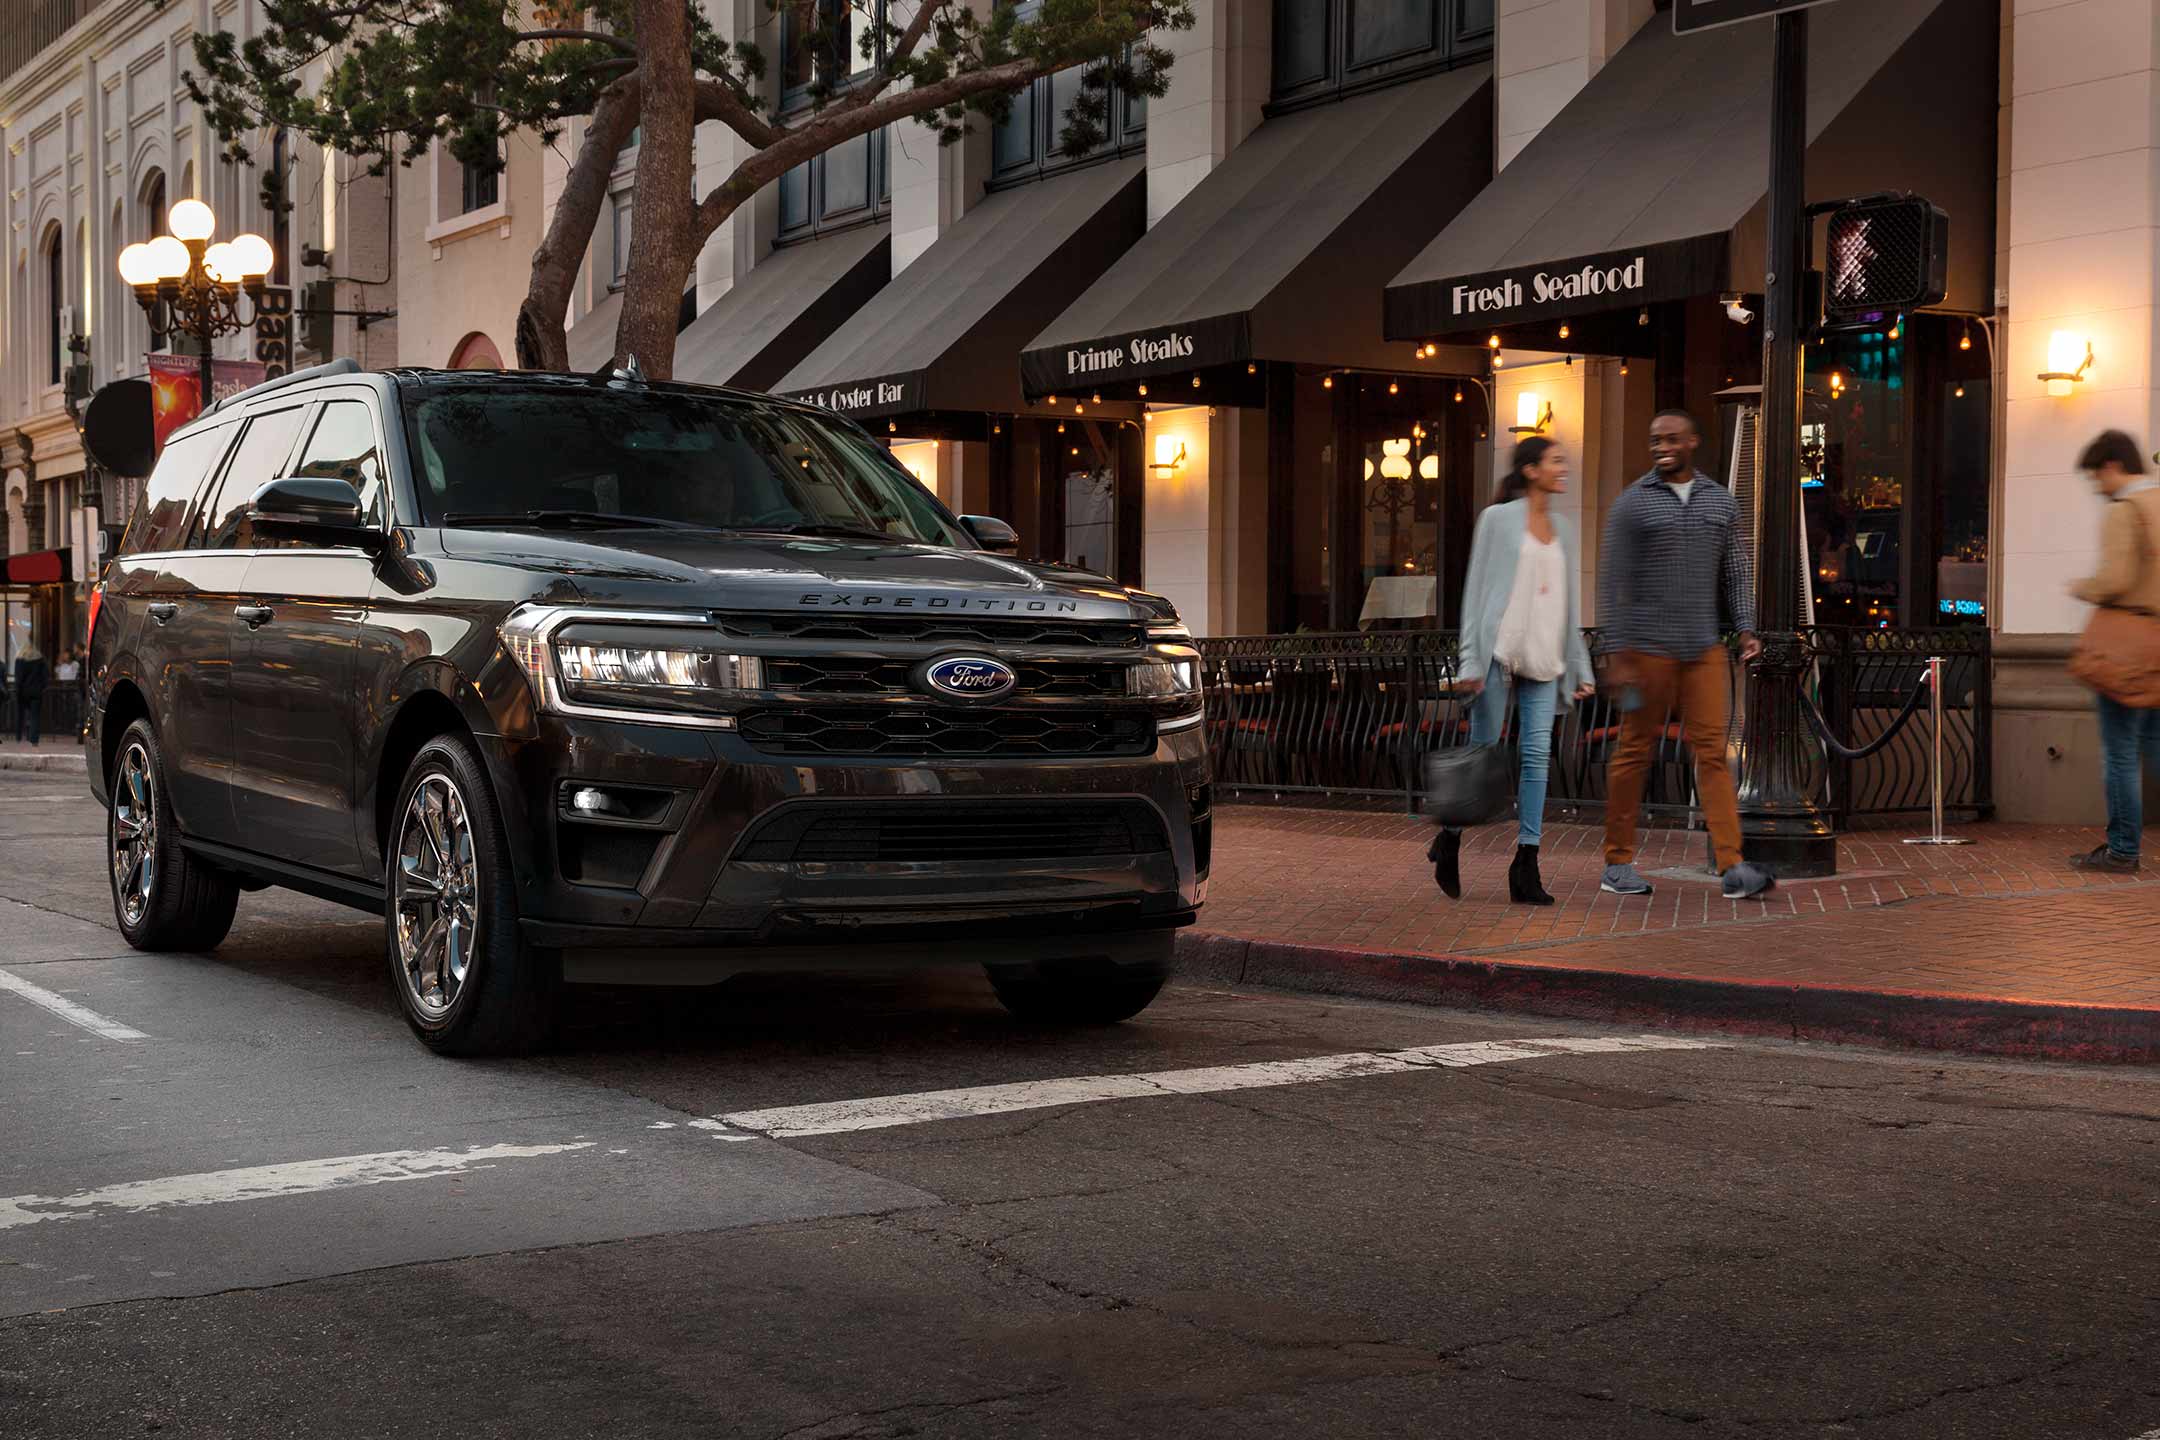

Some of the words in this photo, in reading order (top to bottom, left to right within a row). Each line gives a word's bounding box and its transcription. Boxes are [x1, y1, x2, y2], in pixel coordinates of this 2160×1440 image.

[1452, 278, 1523, 315] Fresh
[1532, 257, 1645, 304] Seafood
[1067, 347, 1124, 375] Prime
[1130, 333, 1194, 365] Steaks
[831, 387, 874, 411] Oyster
[878, 382, 905, 404] Bar
[799, 593, 1077, 612] EXPEDITION
[949, 664, 996, 688] Ford
